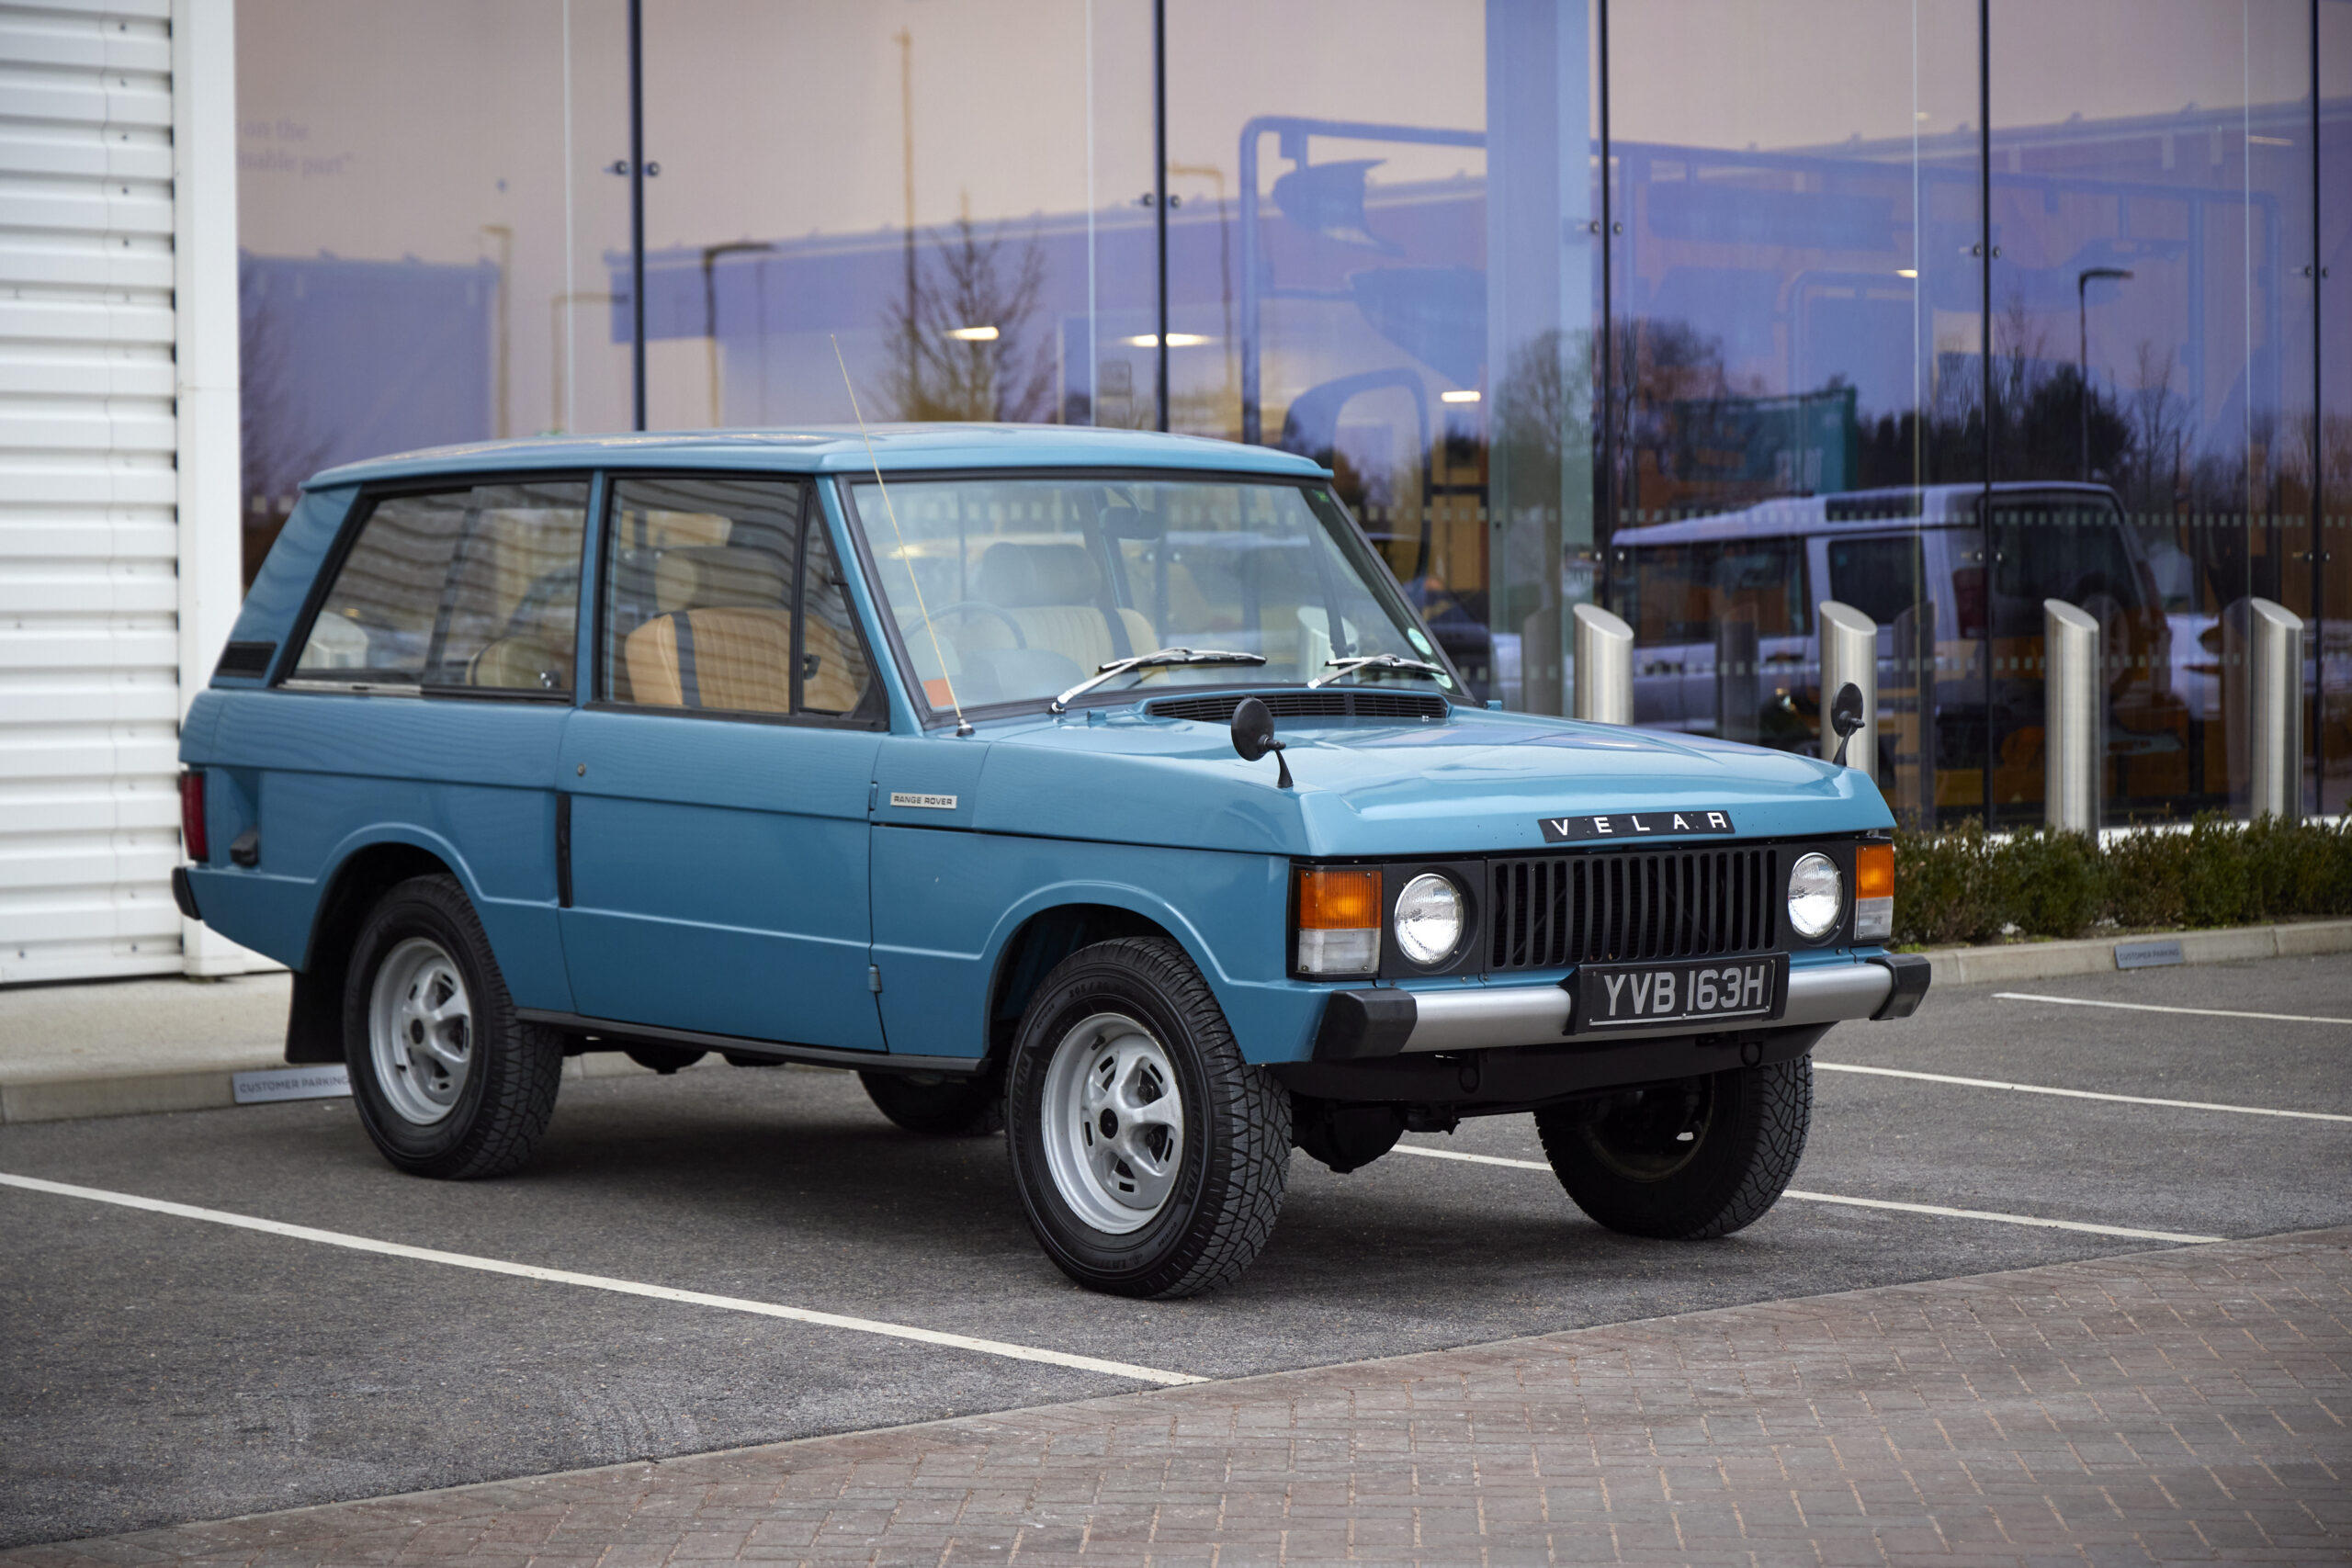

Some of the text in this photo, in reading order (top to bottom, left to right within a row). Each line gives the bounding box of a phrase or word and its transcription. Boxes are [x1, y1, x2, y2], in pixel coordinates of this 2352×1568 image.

[276, 118, 310, 141] the
[894, 795, 953, 806] RANGE ROVER
[1551, 812, 1727, 836] VELAR
[2119, 948, 2180, 962] CUSTOMER PARKING
[1604, 965, 1765, 1016] YVB 163H
[239, 1078, 299, 1094] CUSTOMER
